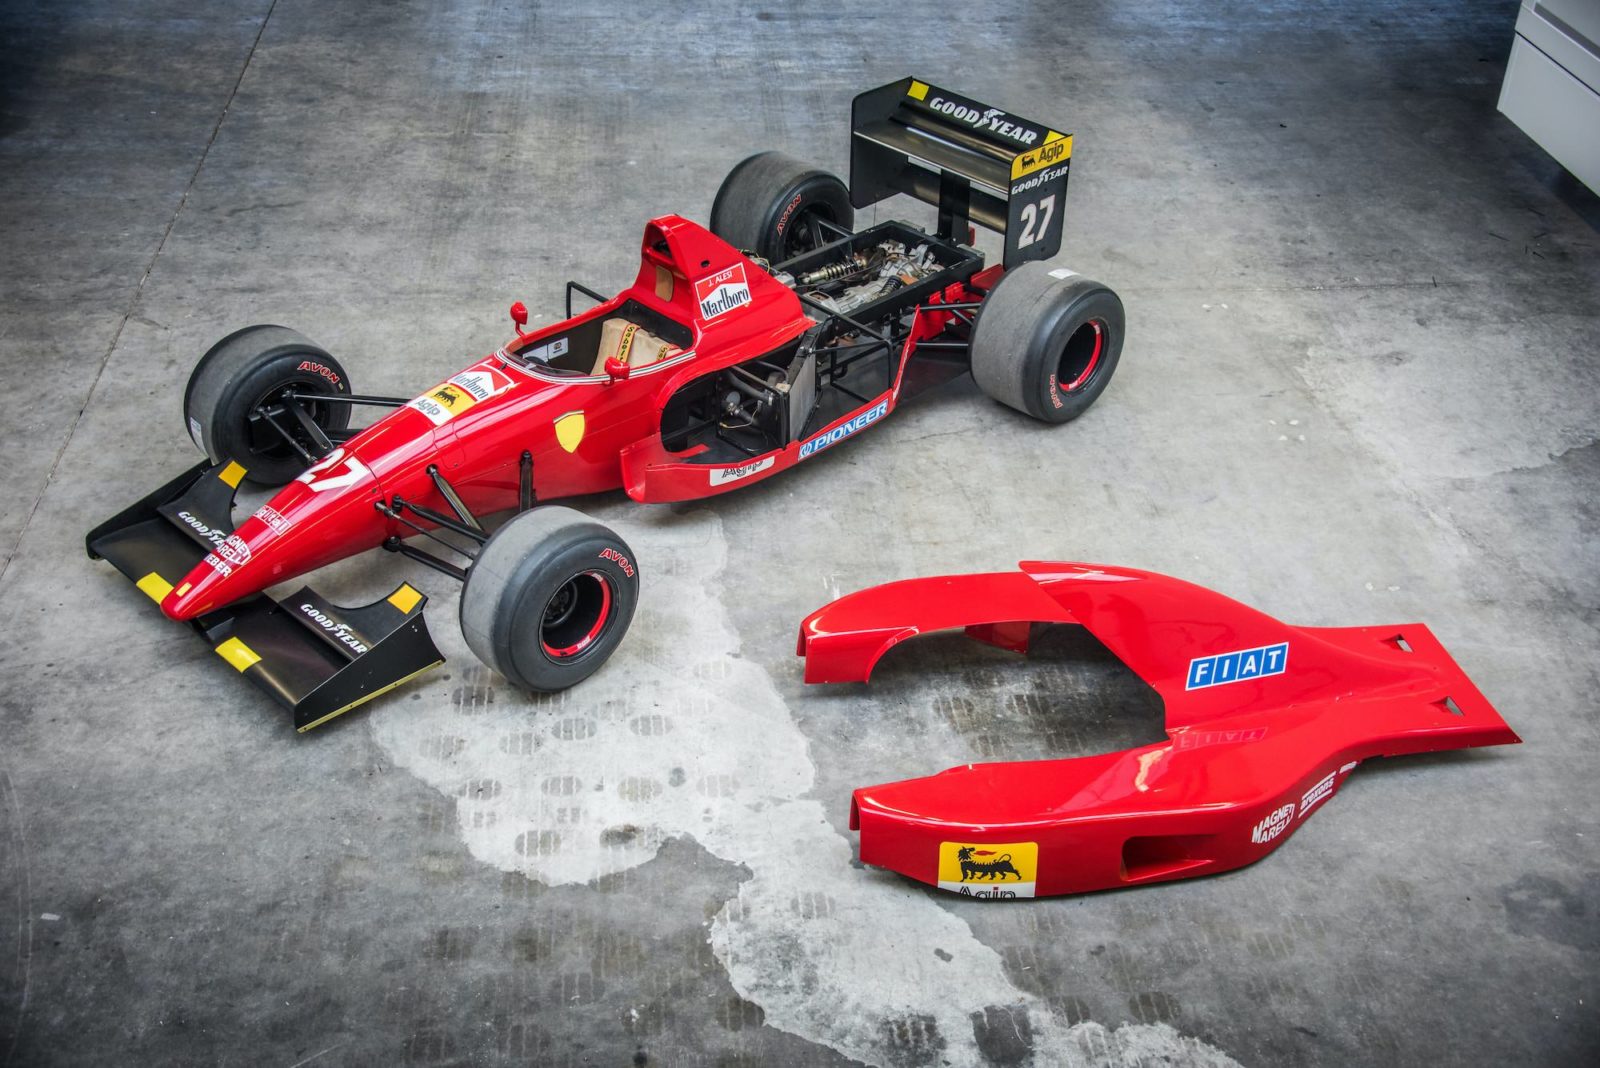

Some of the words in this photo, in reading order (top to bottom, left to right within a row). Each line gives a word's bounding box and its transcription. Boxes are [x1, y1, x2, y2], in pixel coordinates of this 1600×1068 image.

[929, 97, 1038, 145] GOODYEAR
[1038, 142, 1065, 163] Agip
[1011, 166, 1069, 195] GOODYEAR
[776, 193, 802, 237] AVON
[1018, 194, 1056, 250] 27
[715, 270, 733, 284] ALESI
[701, 287, 749, 319] Marlboro
[297, 361, 340, 384] AVON
[1049, 374, 1064, 409] AVON
[814, 401, 888, 449] PIONEER
[295, 448, 371, 493] 27
[178, 511, 226, 549] GOODYE
[203, 553, 232, 577] EBER
[598, 547, 636, 578] AVON
[300, 603, 368, 654] GOODYEAR
[1194, 649, 1283, 684] FIAT
